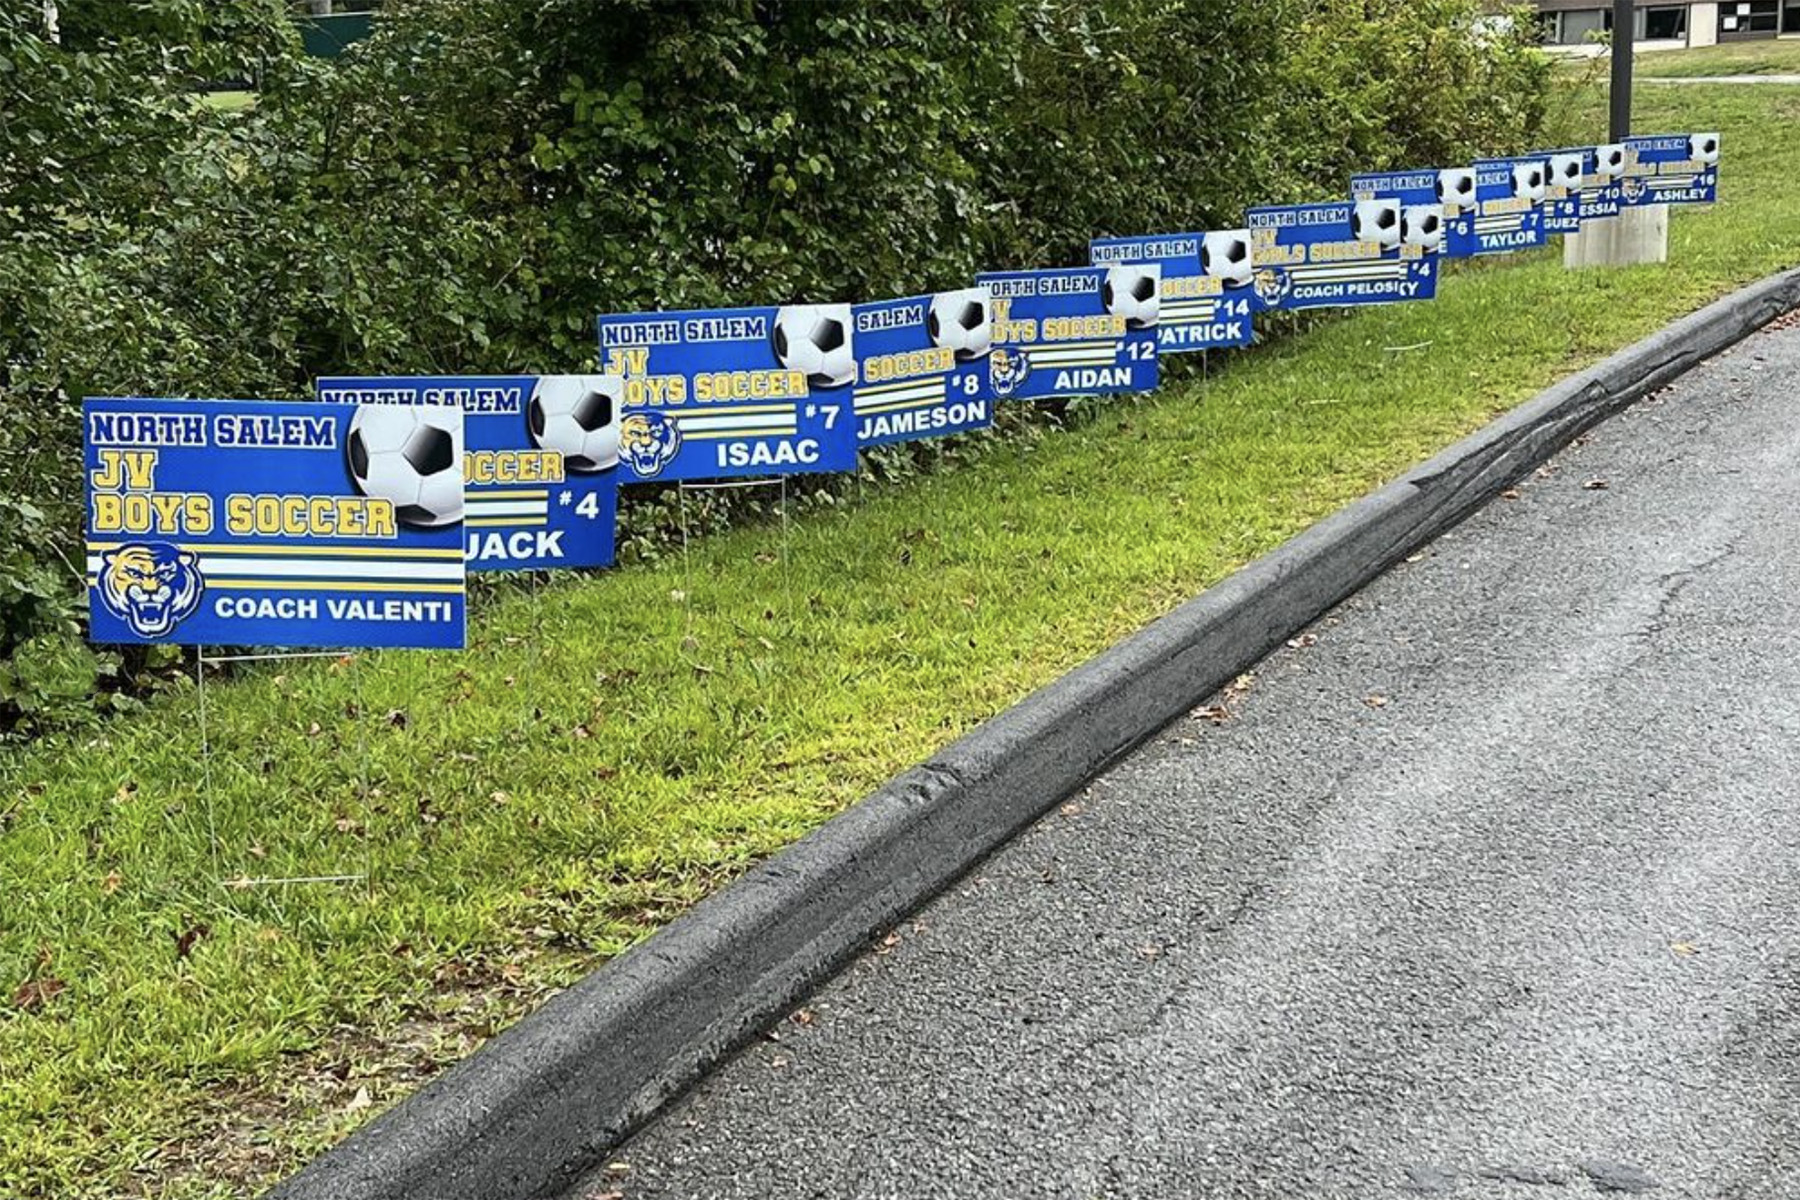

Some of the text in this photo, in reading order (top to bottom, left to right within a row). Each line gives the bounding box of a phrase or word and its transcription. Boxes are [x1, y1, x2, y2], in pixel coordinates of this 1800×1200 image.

[1653, 188, 1707, 201] ASHLEY
[1249, 207, 1349, 228] NORTH SALEM
[1579, 202, 1618, 216] ESSIA
[1092, 239, 1198, 262] NORTH SALEM
[1480, 230, 1537, 248] TAYLOR
[979, 275, 1099, 298] ORTH SALEM
[1160, 275, 1224, 299] OCCER
[1293, 285, 1343, 298] COACH
[602, 317, 766, 346] NORTH SALEM
[858, 304, 924, 332] SALEM
[988, 314, 1127, 344] OYS SOCCER
[1157, 321, 1242, 345] ATRICK
[604, 347, 649, 378] JV
[864, 346, 956, 382] SOCCER
[622, 369, 809, 407] OYS SOCCER
[1054, 367, 1132, 389] AIDAN
[90, 413, 336, 449] NORTH SALEM
[805, 404, 840, 430] #7
[857, 400, 986, 439] JAMESON
[717, 438, 820, 467] ISAAC
[92, 449, 158, 490] JV
[91, 491, 398, 538] BOYS SOCCER
[559, 490, 600, 519] #4
[465, 531, 565, 561] JACK
[215, 598, 452, 622] COACH VALENTI
